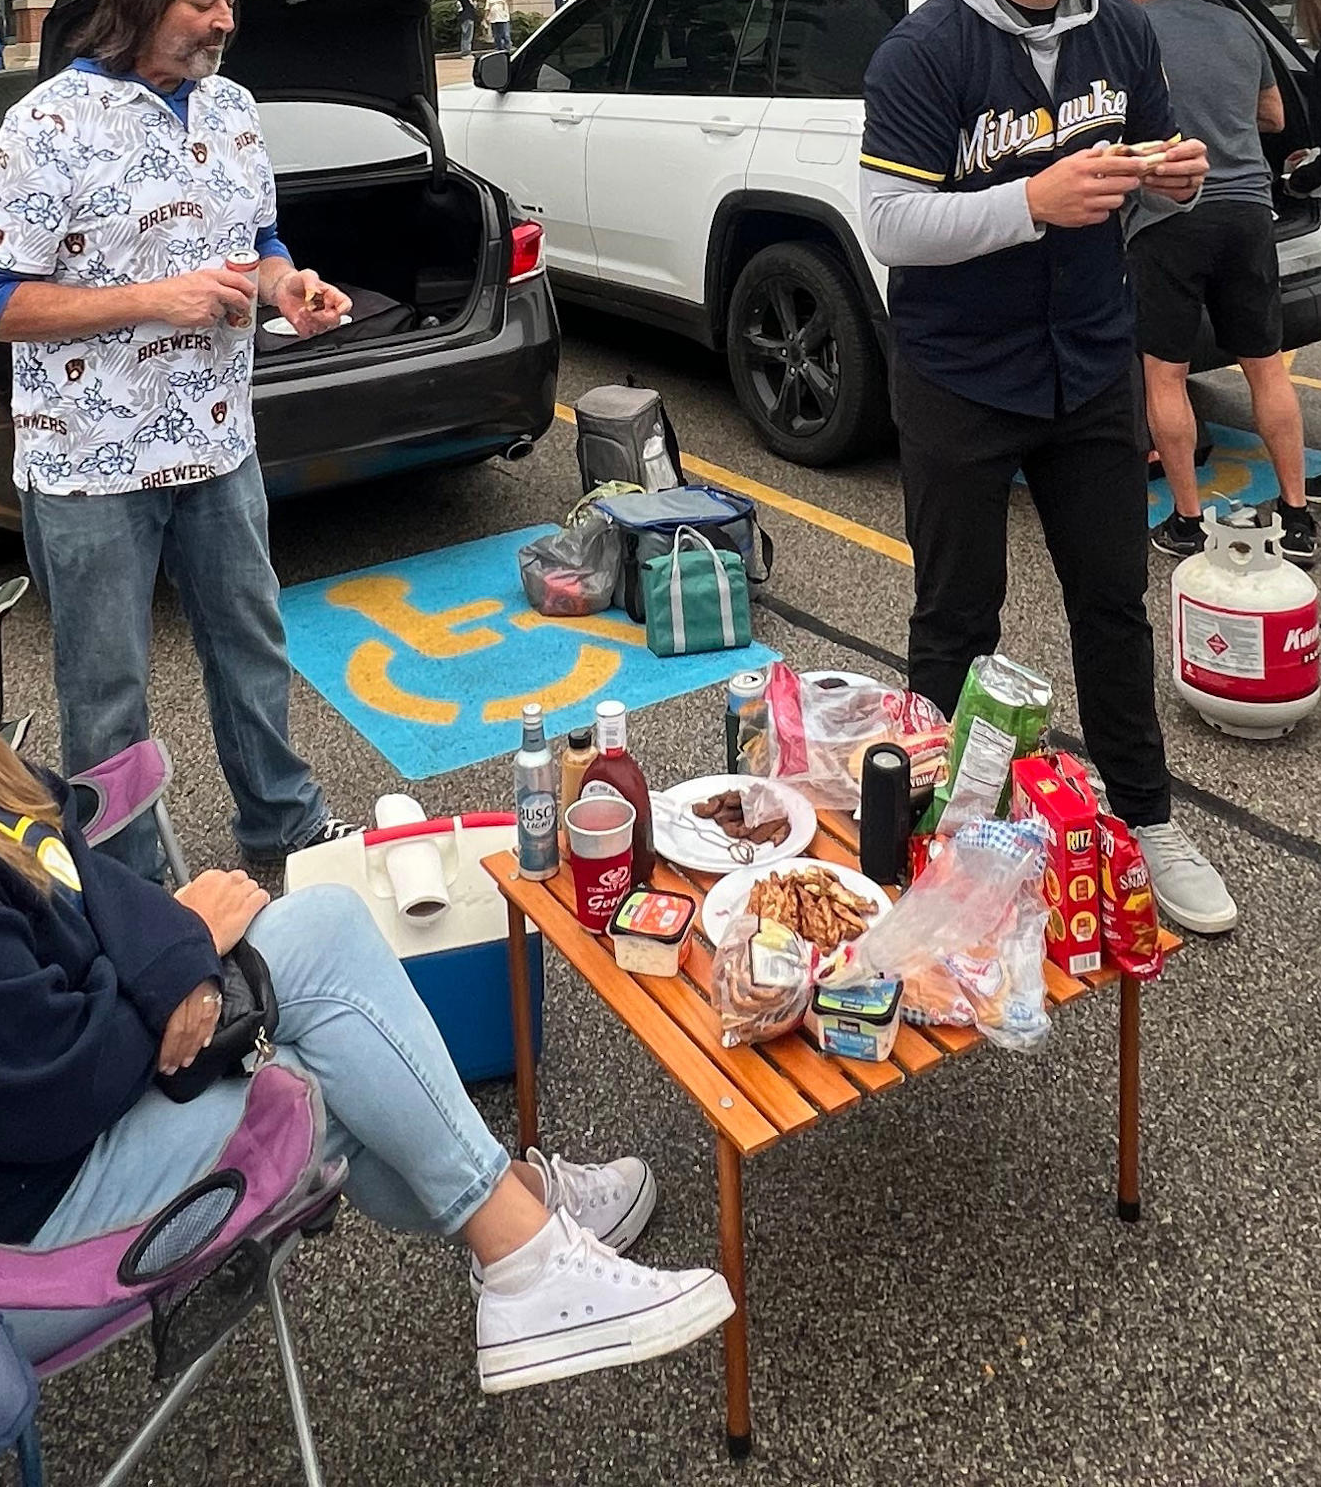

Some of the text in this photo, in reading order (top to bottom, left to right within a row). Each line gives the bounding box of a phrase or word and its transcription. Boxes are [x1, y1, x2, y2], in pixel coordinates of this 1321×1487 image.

[138, 201, 204, 235] BREWERS
[137, 333, 213, 364] BREWERS
[141, 464, 218, 490] BREWERS
[1066, 828, 1094, 852] RITZ
